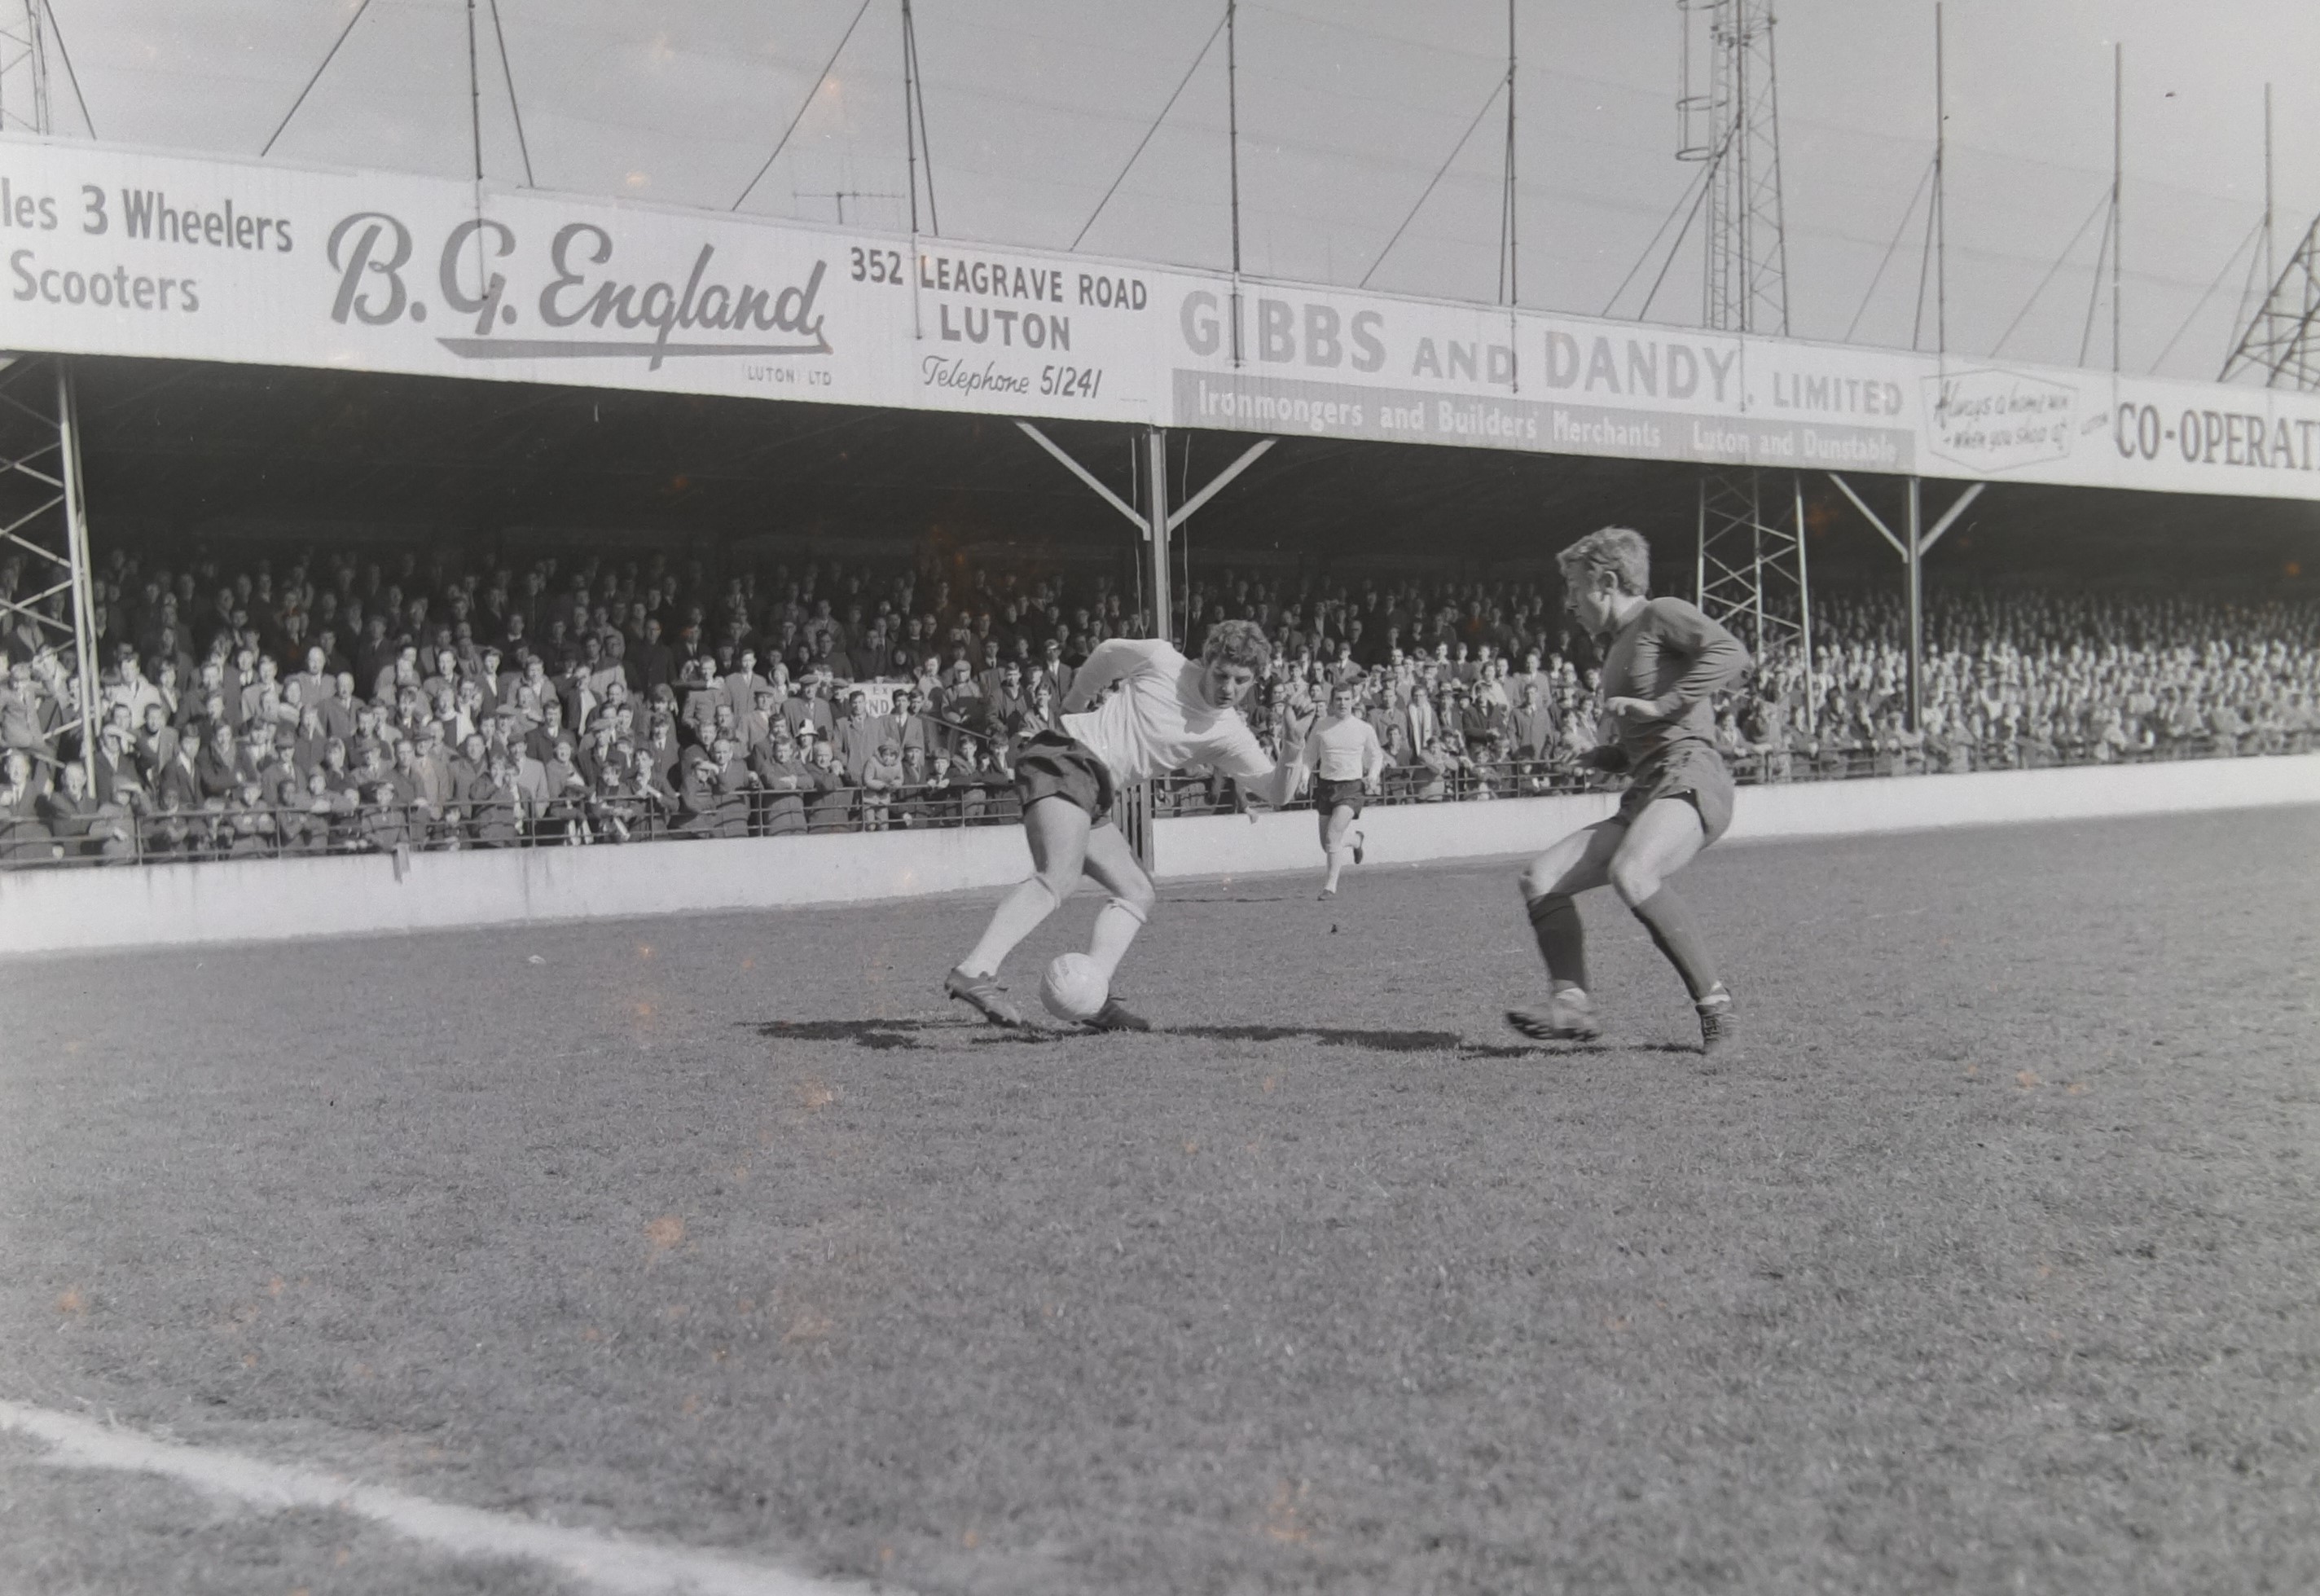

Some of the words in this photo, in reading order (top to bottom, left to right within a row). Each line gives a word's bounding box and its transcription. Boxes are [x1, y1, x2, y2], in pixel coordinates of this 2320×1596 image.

[81, 184, 109, 235] 3
[121, 187, 294, 253] Wheelers
[10, 248, 200, 313] Scooters
[538, 222, 834, 372] England
[850, 246, 903, 286] 352
[920, 254, 1064, 303] LEAGRAVE
[1079, 273, 1148, 311] ROAD
[939, 303, 1071, 352] LUTON
[1179, 289, 1386, 373] GIBBS
[1412, 336, 1516, 385] AND
[1773, 372, 1904, 416] LIMITED
[808, 370, 832, 386] LTD
[921, 354, 1030, 397] Telephone
[1039, 364, 1103, 399] 51241
[1198, 379, 1364, 433] Ironmongers
[1380, 402, 1425, 431] and
[1553, 410, 1662, 449] Merchants
[1693, 420, 1751, 453] Luton
[1760, 431, 1792, 456] and
[1804, 429, 1896, 464] Dunstable
[2116, 402, 2320, 471] CO-OPERAT
